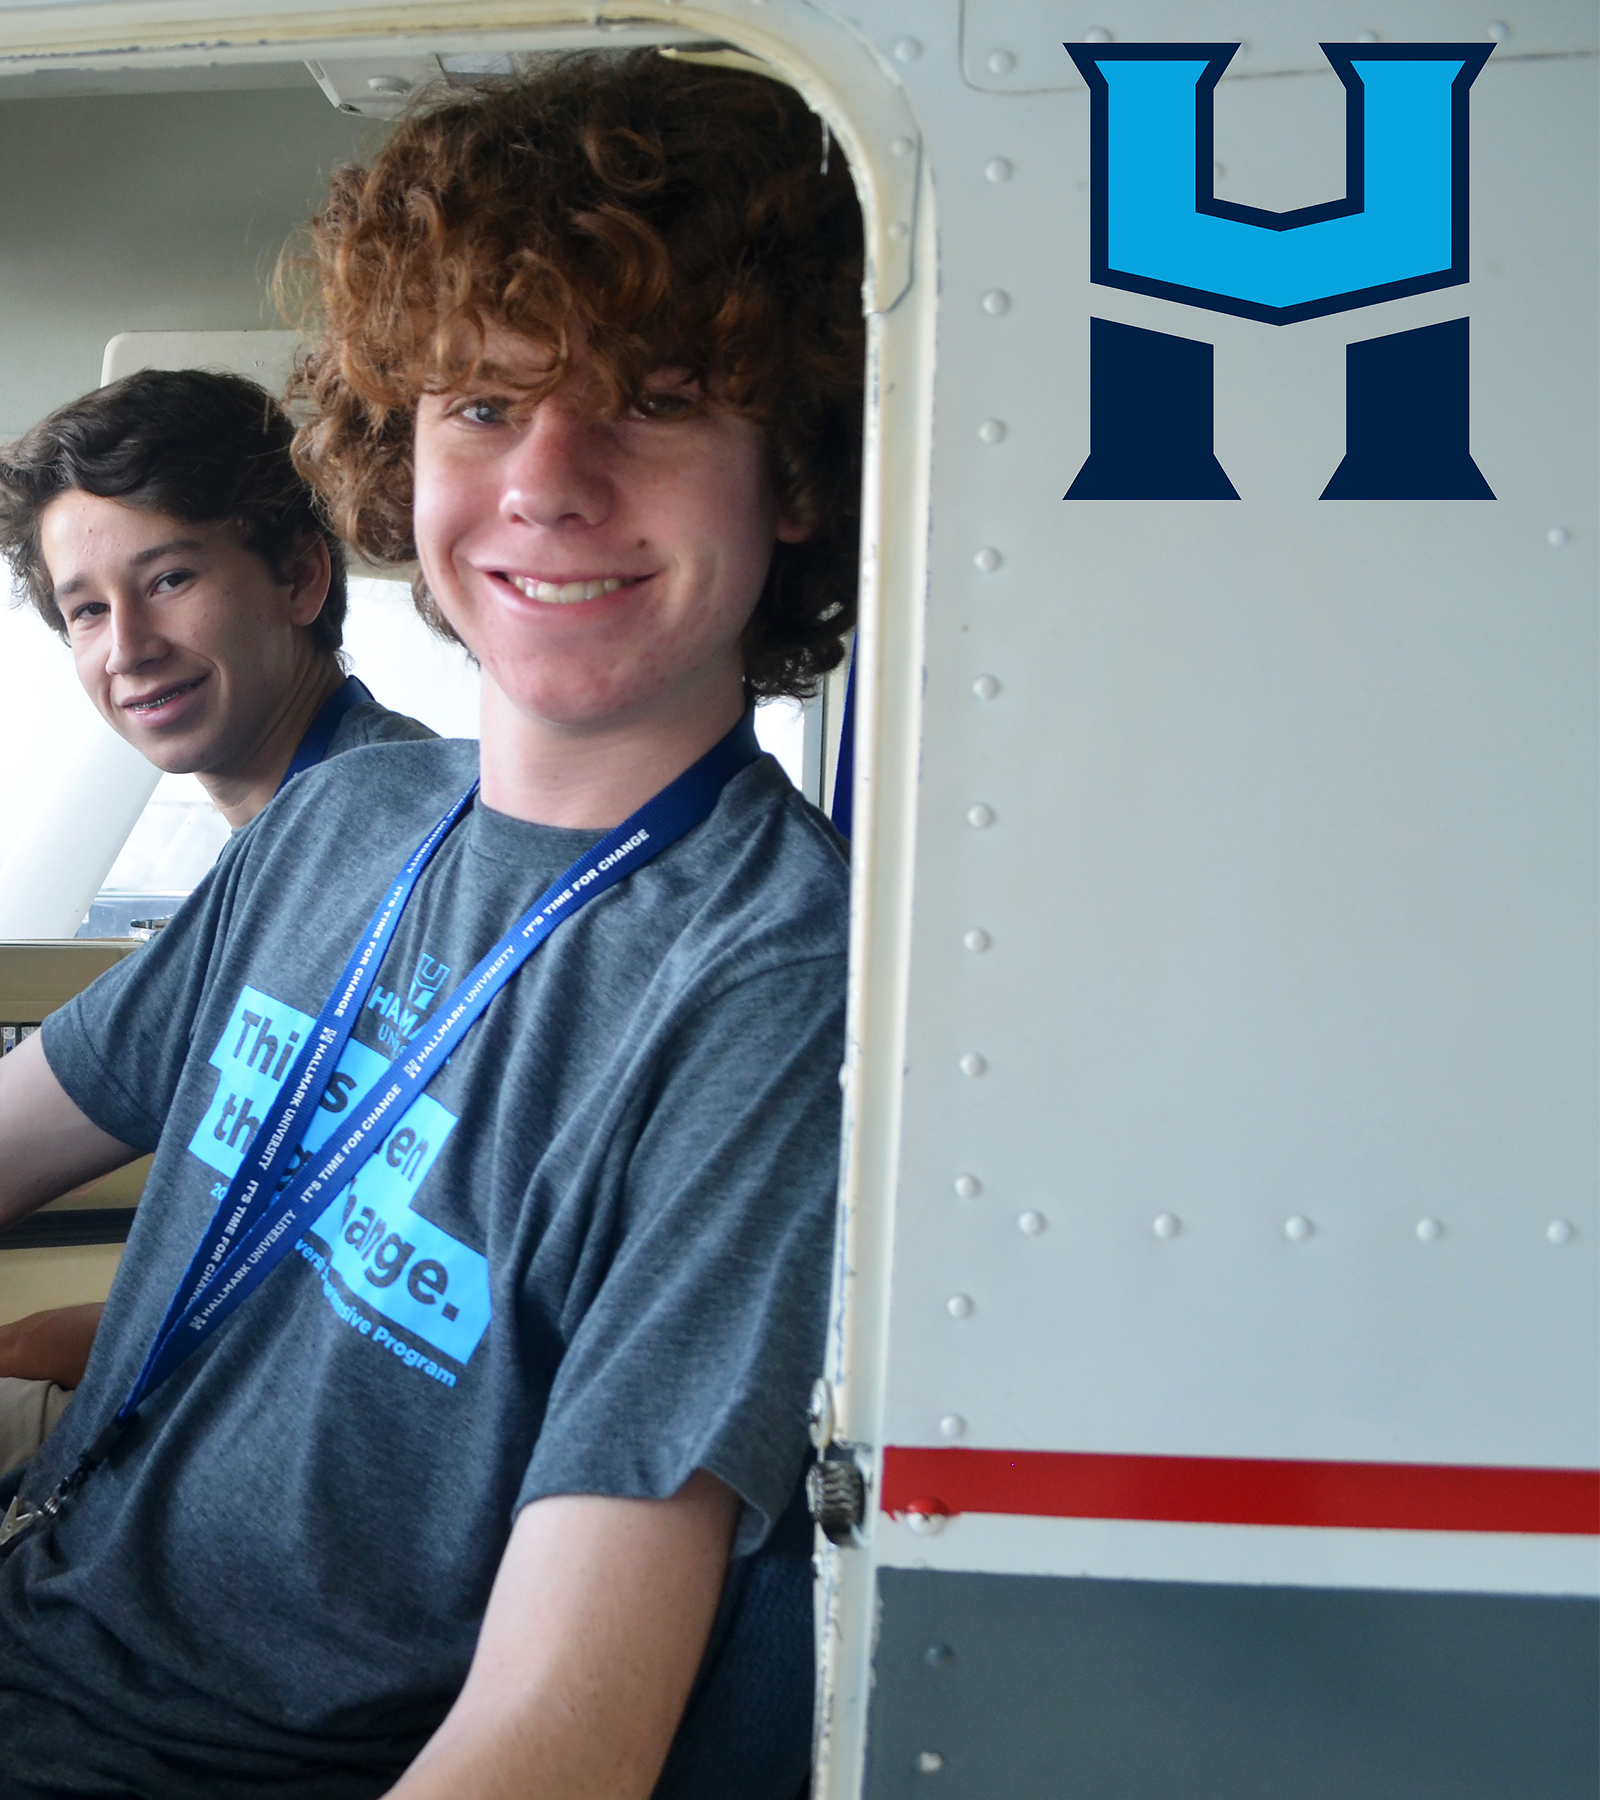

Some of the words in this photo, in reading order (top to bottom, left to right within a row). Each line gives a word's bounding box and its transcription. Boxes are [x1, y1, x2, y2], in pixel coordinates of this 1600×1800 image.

[521, 914, 545, 938] IT'S
[542, 888, 574, 915] TIME
[571, 867, 600, 892] FOR
[597, 828, 650, 872] CHANGE
[360, 940, 377, 966] FOR
[372, 910, 392, 939] TIME
[333, 967, 364, 1018] CHANGE
[416, 1002, 467, 1064] HALLMARK
[464, 944, 516, 1003] UNIVERSITY
[289, 1042, 328, 1108] HALLMARK
[257, 1108, 298, 1172] UNIVERSITY
[300, 1179, 323, 1204] IT'S
[317, 1151, 346, 1181] TIME
[341, 1129, 365, 1156] FOR
[361, 1083, 403, 1132] CHANGE
[224, 1205, 248, 1236] TIME
[240, 1179, 260, 1204] IT'S
[201, 1262, 252, 1317] HALLMARK
[246, 1208, 297, 1264] UNIVERSITY
[211, 1235, 231, 1262] FOR
[372, 1325, 458, 1389] Program
